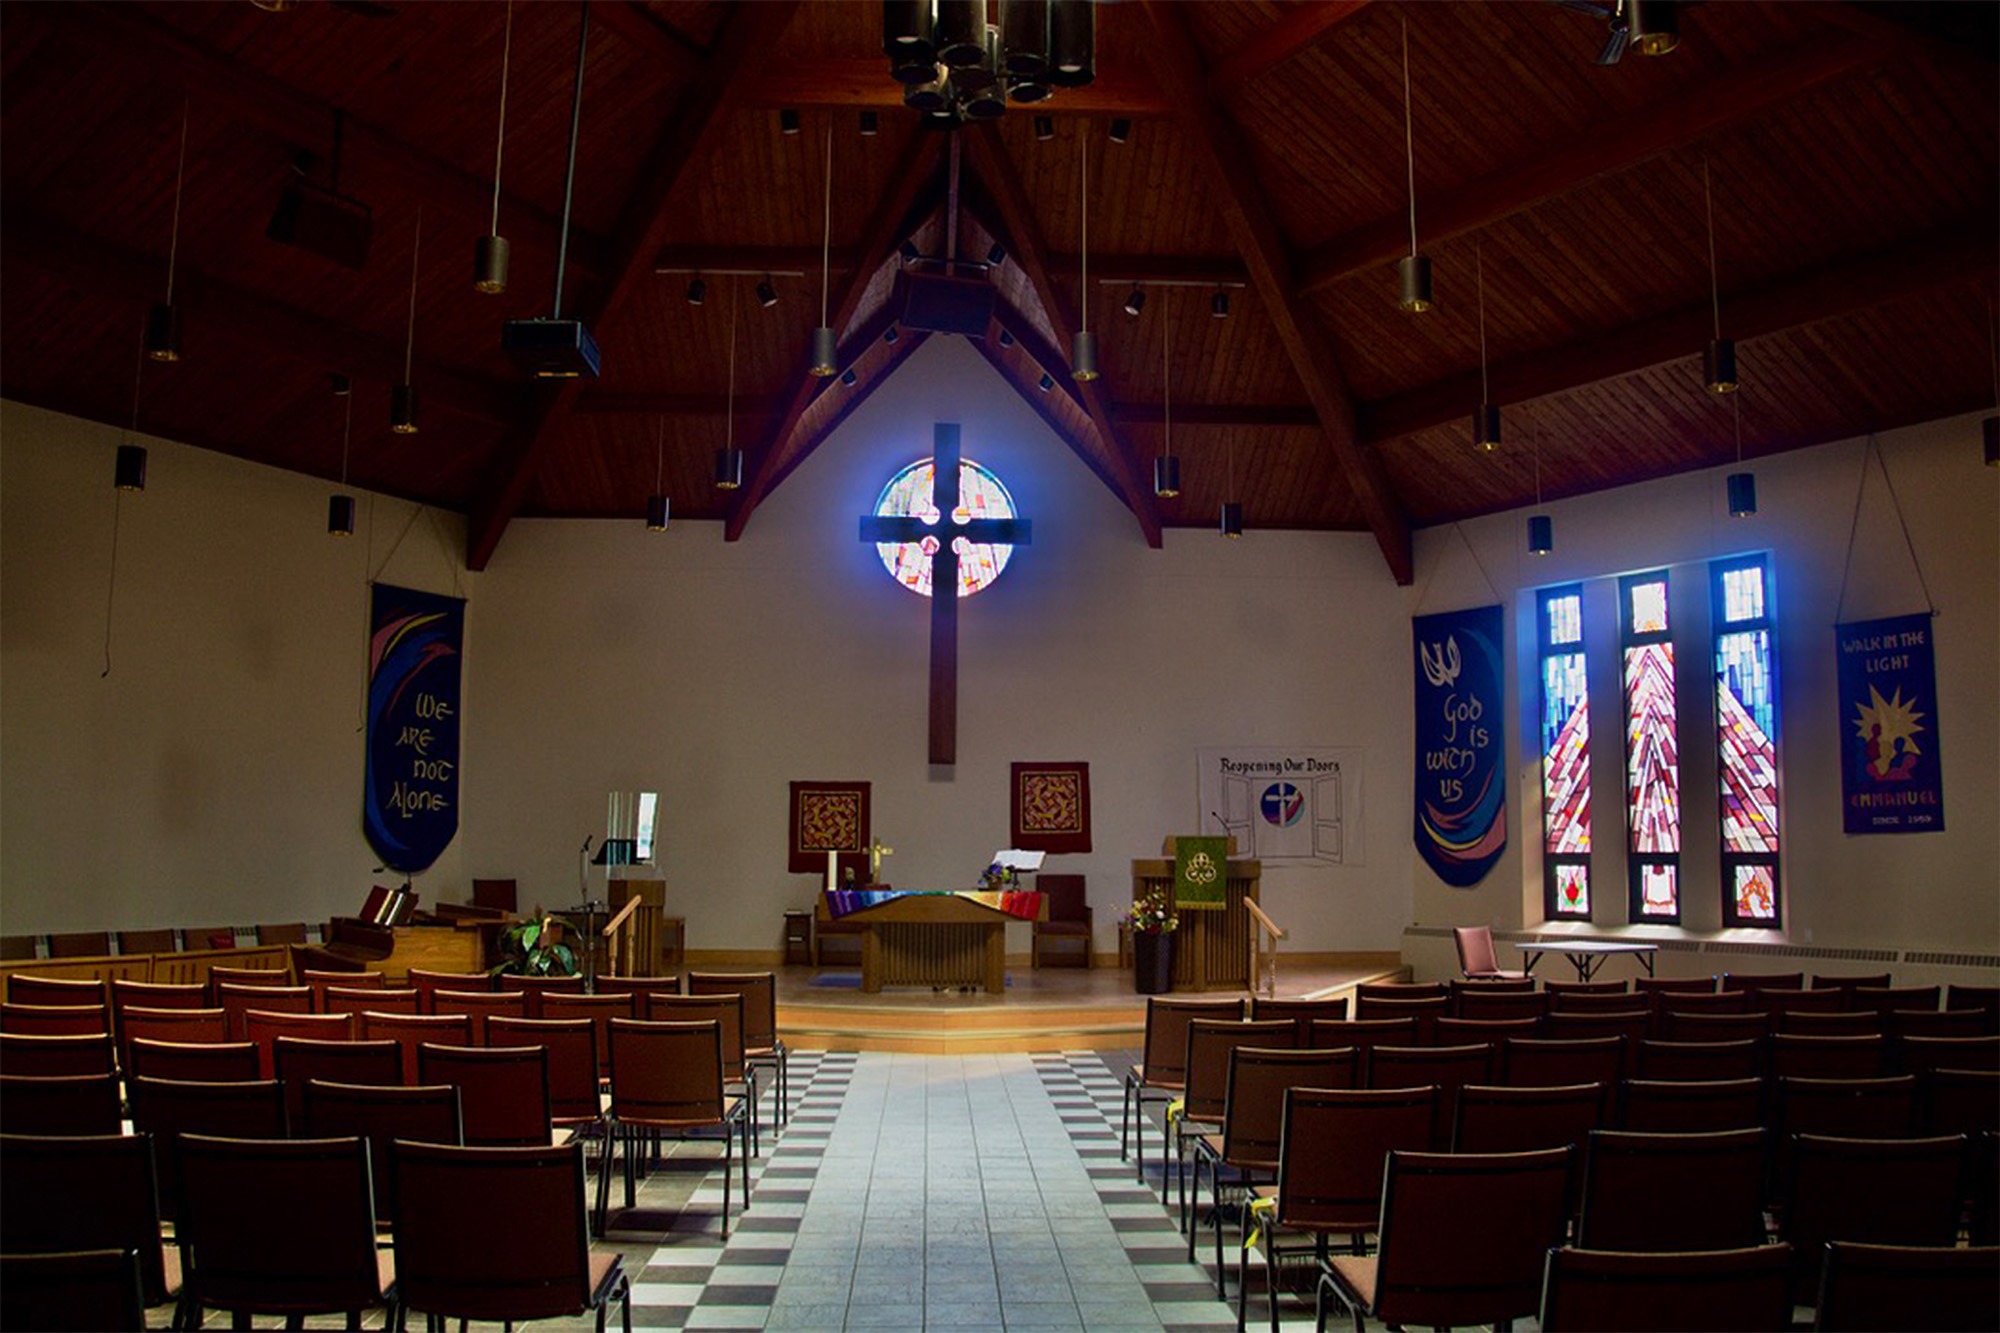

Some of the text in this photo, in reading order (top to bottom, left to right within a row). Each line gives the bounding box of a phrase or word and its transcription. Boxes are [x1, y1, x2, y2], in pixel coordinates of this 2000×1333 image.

[1842, 631, 1925, 653] WALK IN THE
[1866, 655, 1909, 673] LIGHT
[1443, 692, 1483, 742] God
[1469, 724, 1489, 748] is
[1220, 757, 1340, 775] Reopening Our Doors
